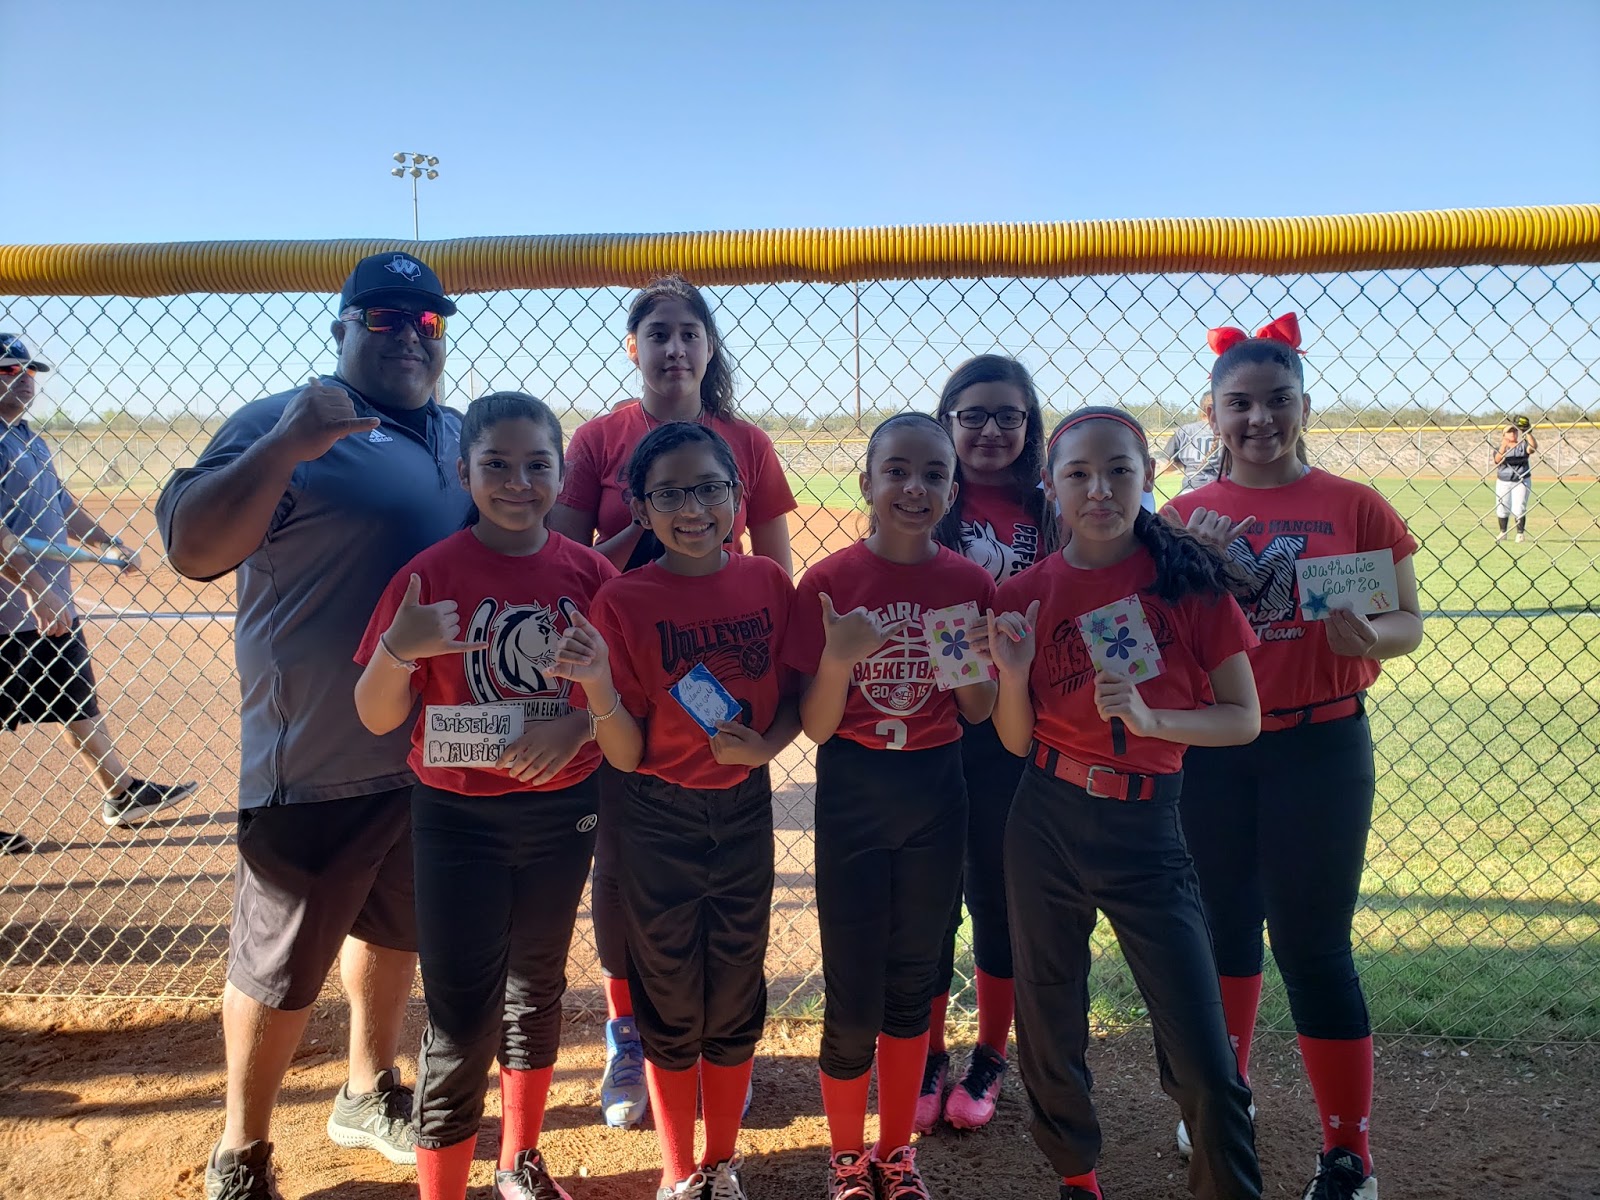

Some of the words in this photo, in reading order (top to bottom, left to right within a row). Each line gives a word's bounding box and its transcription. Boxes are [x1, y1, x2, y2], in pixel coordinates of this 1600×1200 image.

[1010, 523, 1039, 577] PERFE
[1302, 556, 1376, 580] Nathalie
[873, 601, 921, 623] GIRL
[1246, 607, 1290, 622] heer
[1253, 621, 1306, 640] Team
[655, 607, 774, 676] VOLLEYBALL
[852, 661, 936, 682] BASKETBA
[871, 685, 890, 699] 20
